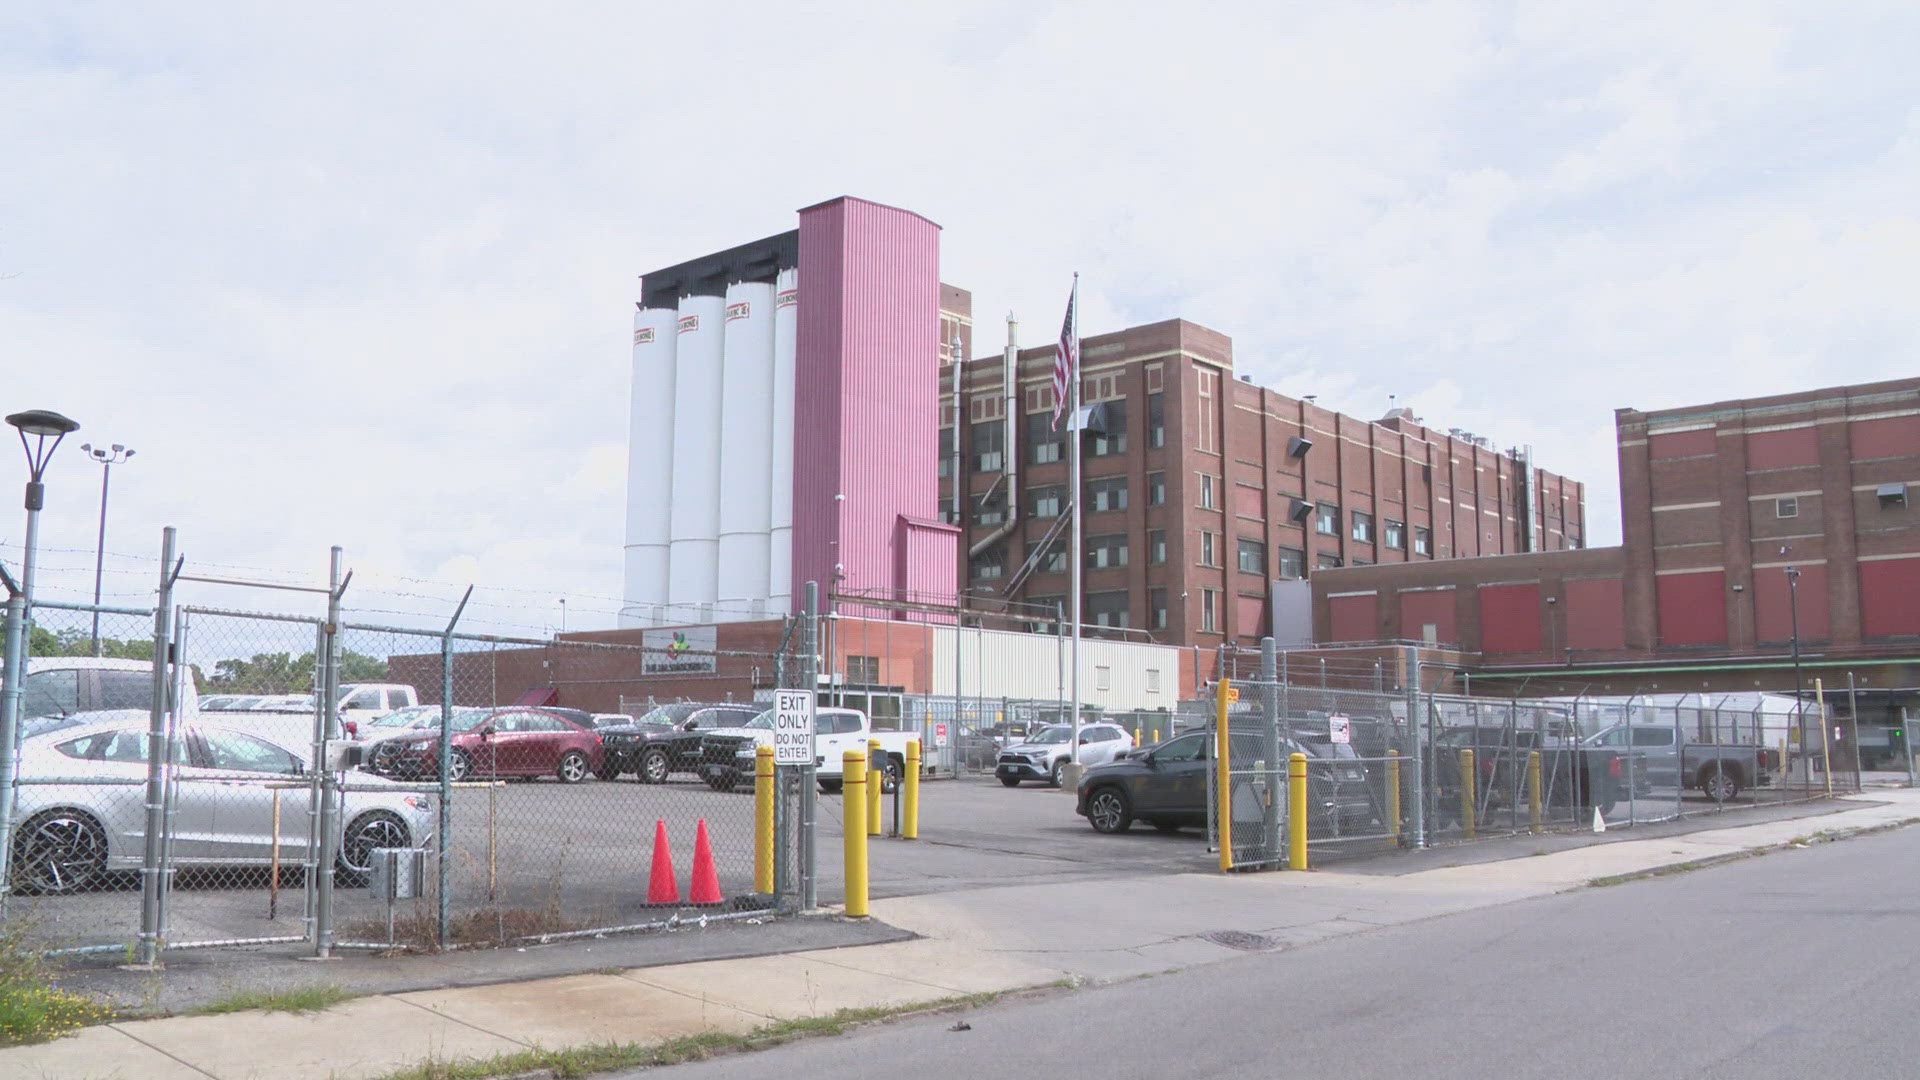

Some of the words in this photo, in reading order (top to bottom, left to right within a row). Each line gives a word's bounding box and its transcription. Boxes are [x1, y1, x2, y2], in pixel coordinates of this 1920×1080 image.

[781, 696, 806, 711] EXIT
[778, 714, 808, 729] ONLY
[776, 733, 789, 745] DO
[792, 733, 810, 745] NOT
[779, 747, 807, 758] ENTER
